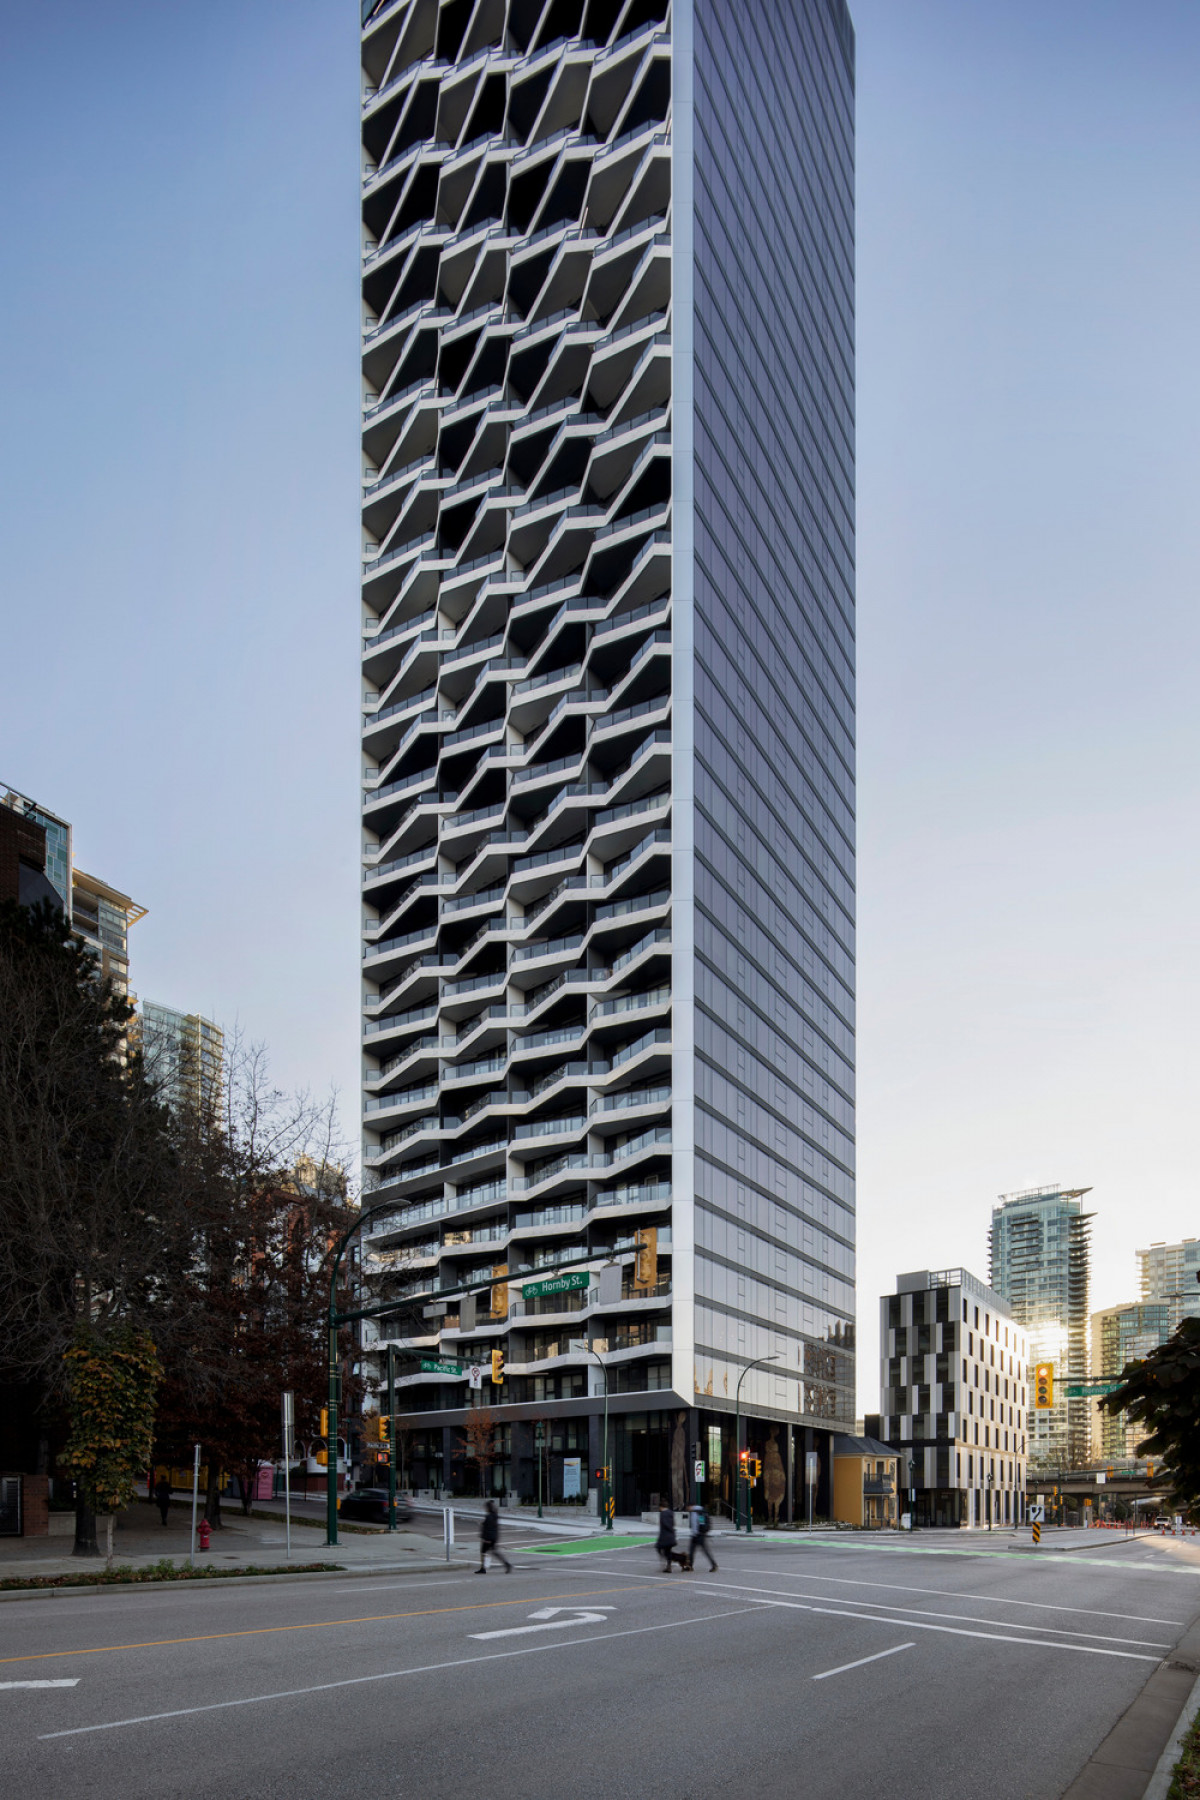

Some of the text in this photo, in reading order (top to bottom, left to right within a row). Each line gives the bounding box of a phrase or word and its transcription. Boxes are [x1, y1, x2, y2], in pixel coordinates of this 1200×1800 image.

[542, 1275, 583, 1291] Hornby St.
[434, 1364, 450, 1373] Pacific
[1081, 1386, 1109, 1394] Hornby
